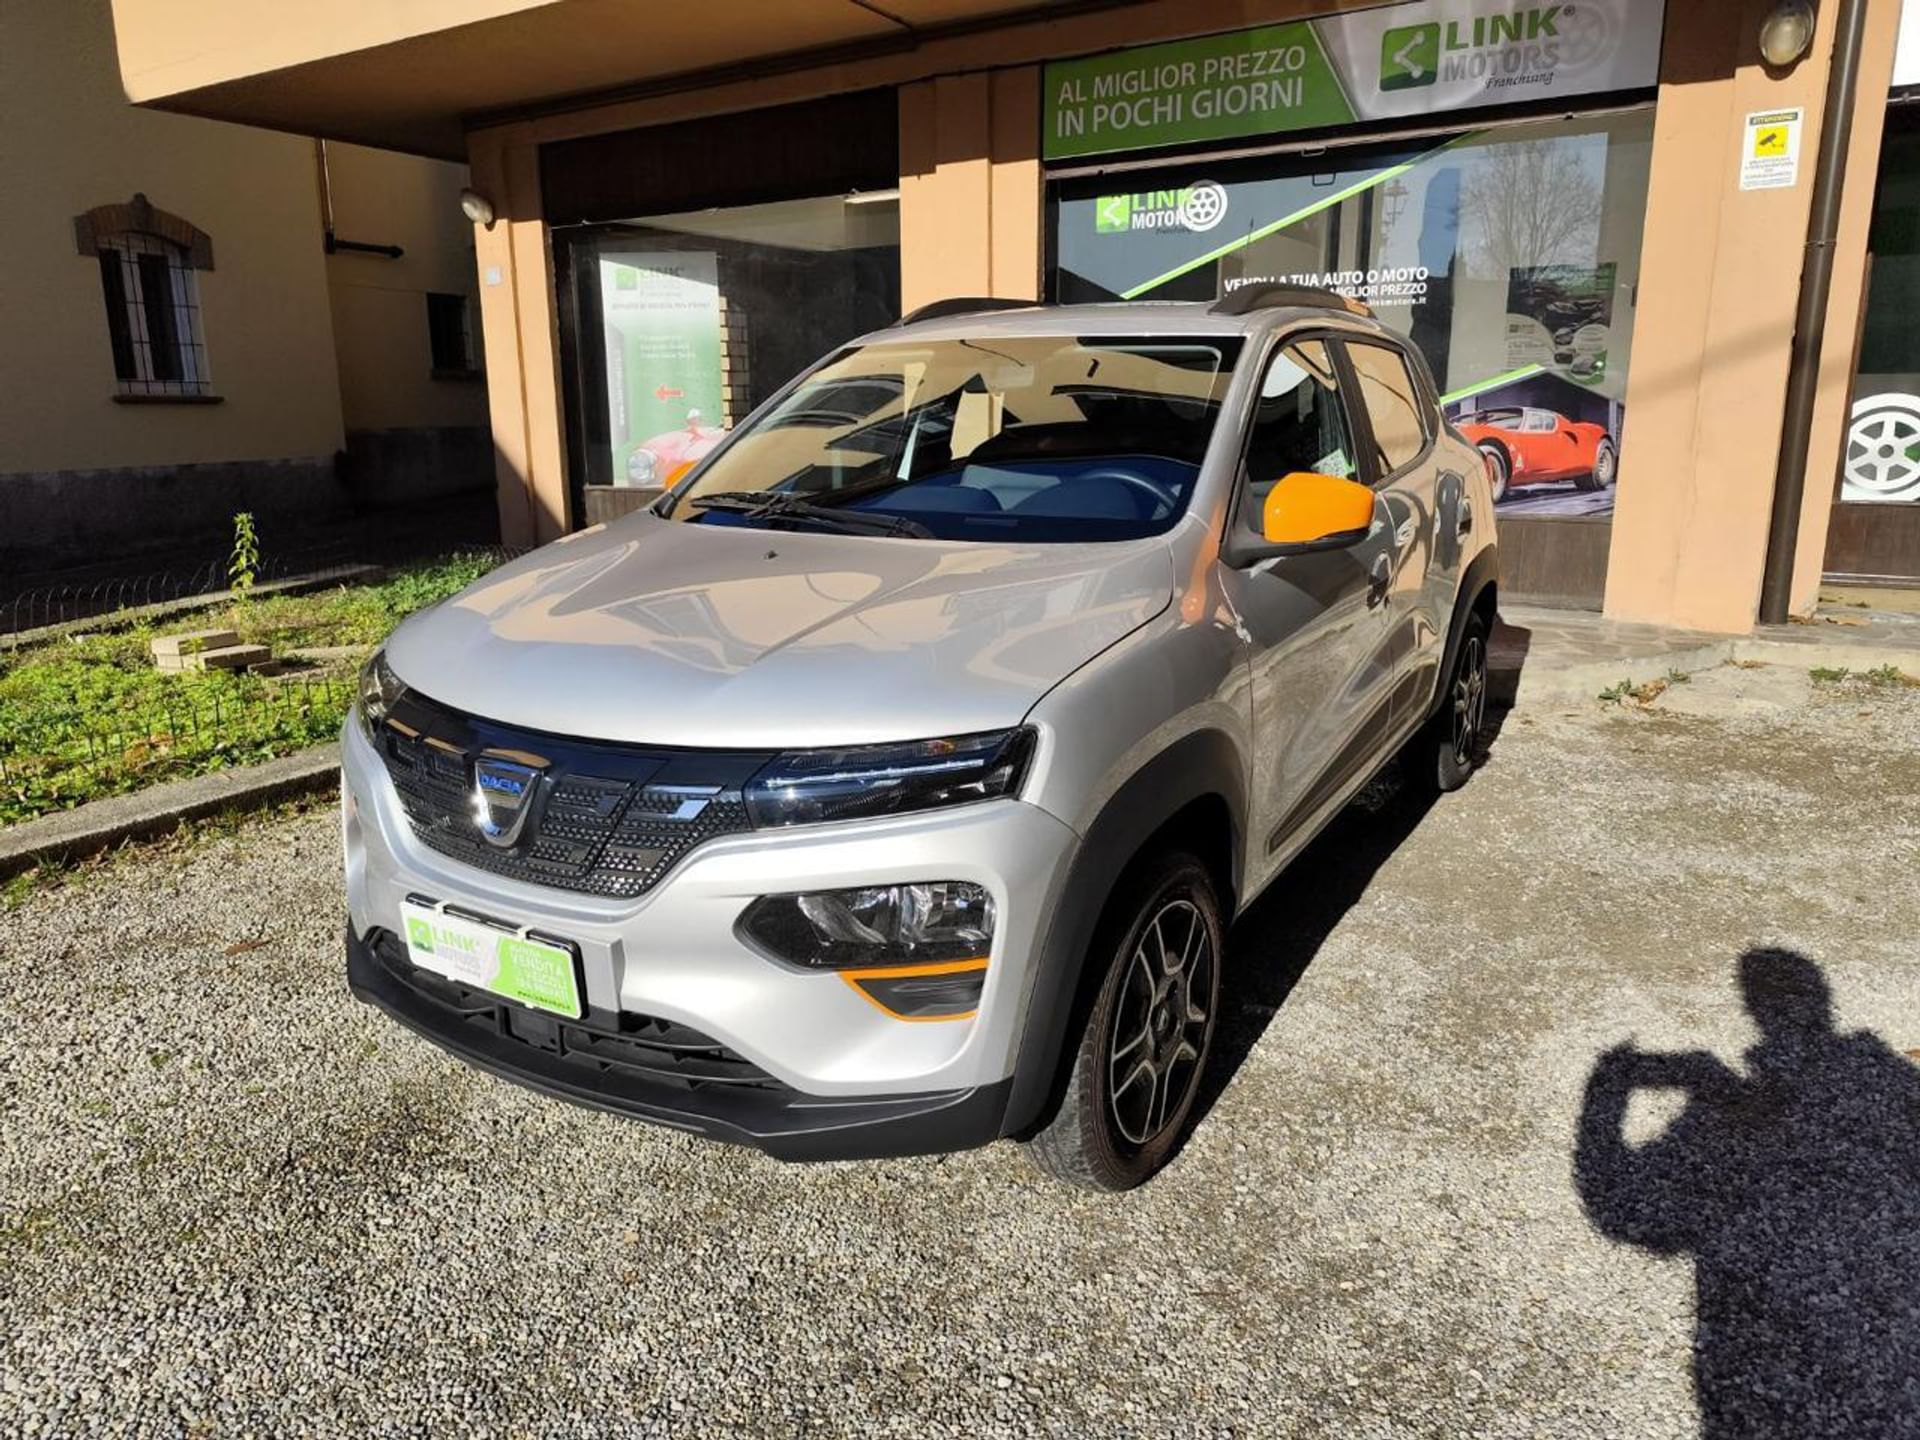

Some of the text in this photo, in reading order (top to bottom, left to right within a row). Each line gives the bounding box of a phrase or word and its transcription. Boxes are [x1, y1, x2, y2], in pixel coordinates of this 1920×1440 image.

[1444, 6, 1563, 51] LINK
[1058, 46, 1306, 105] AL MIGLIOR PREZZO
[1444, 43, 1560, 82] MOTORS
[1057, 76, 1303, 138] IN POCHI GIORNI
[1290, 273, 1320, 287] TUA
[1322, 271, 1363, 287] AUTO
[1366, 270, 1378, 284] O
[1381, 267, 1428, 283] MOTO
[1380, 282, 1427, 296] PREZZO
